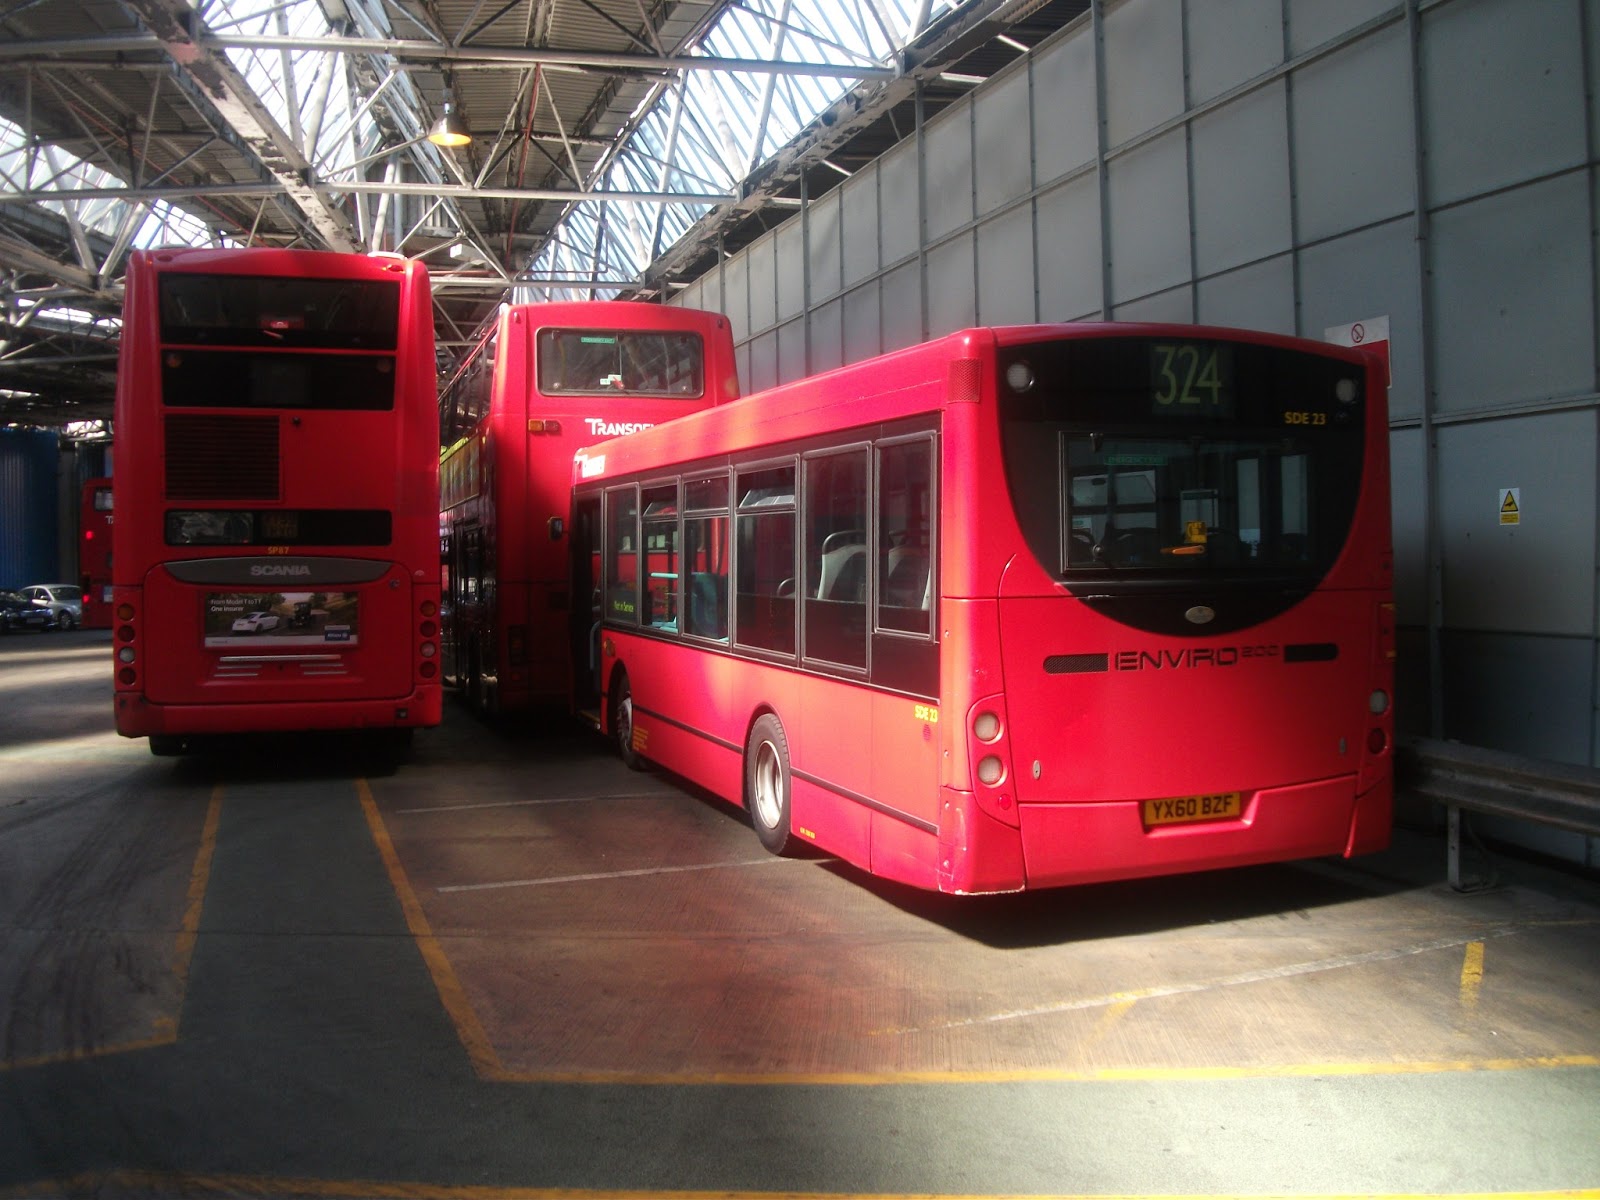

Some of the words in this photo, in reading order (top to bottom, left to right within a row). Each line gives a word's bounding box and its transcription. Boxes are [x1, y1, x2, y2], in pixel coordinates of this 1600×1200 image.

[1153, 345, 1222, 405] 324
[1284, 411, 1309, 424] SDE
[1311, 412, 1326, 425] 23
[584, 418, 655, 436] TRANSD
[267, 546, 290, 555] SP87
[250, 565, 311, 576] SCANIA
[1152, 798, 1197, 820] YX60
[1201, 794, 1234, 815] BZF
